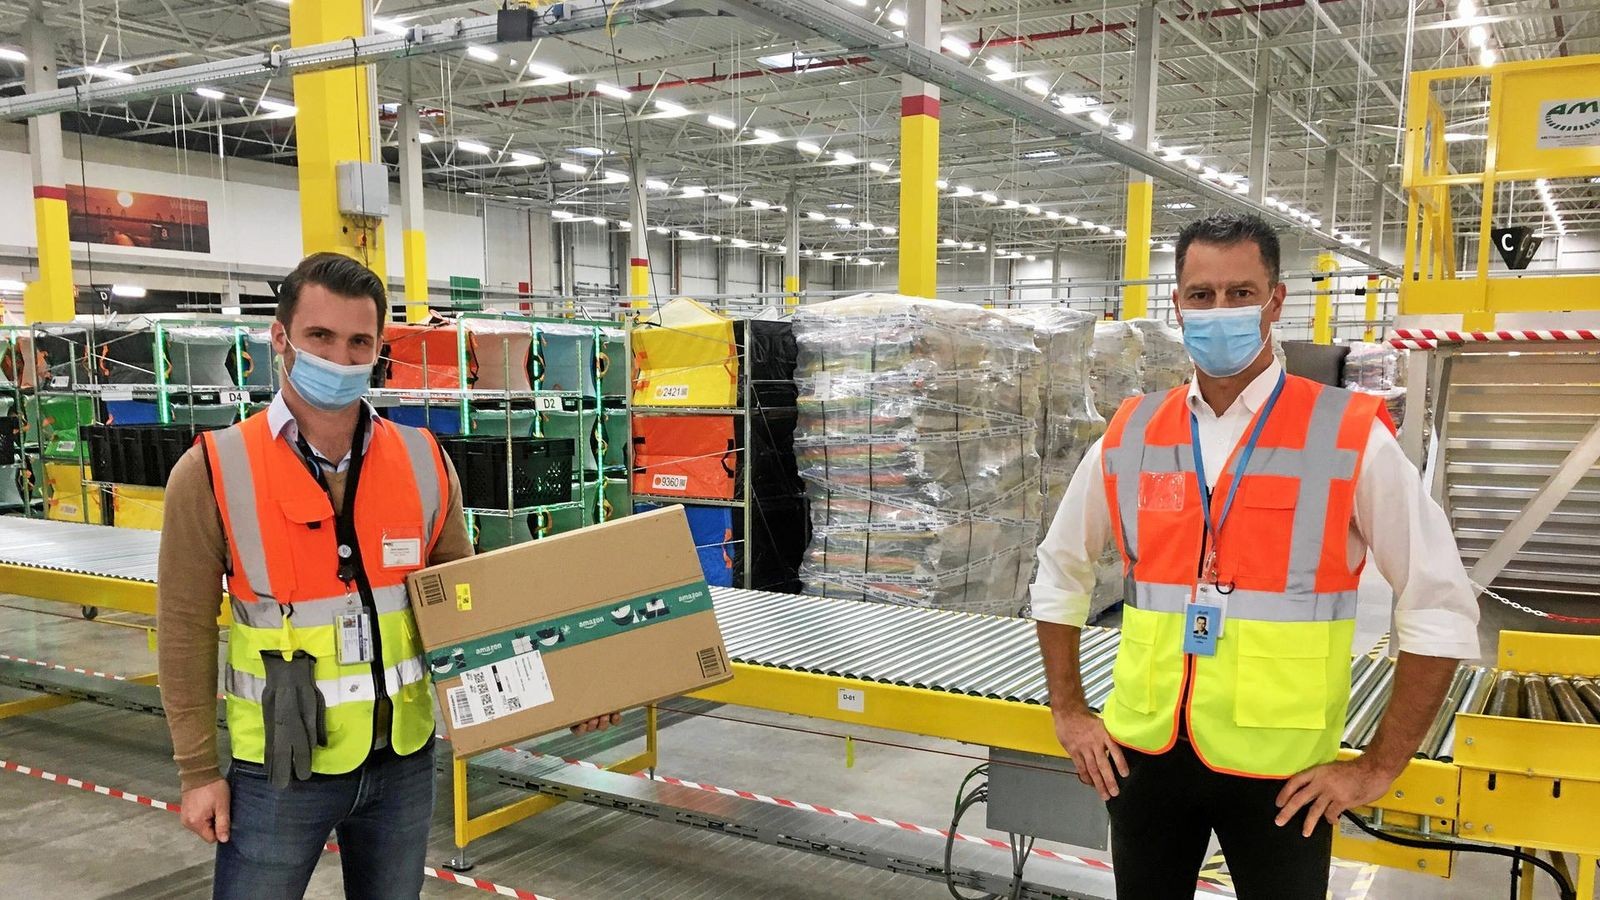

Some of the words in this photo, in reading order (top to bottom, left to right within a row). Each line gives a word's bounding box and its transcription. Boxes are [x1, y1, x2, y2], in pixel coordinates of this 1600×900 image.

[1501, 233, 1514, 251] C
[229, 392, 242, 402] D4
[663, 387, 680, 397] 2421
[543, 398, 555, 408] D2
[661, 476, 679, 488] 9360
[678, 591, 703, 603] amazon
[578, 616, 605, 629] amazon
[475, 642, 503, 655] amazon
